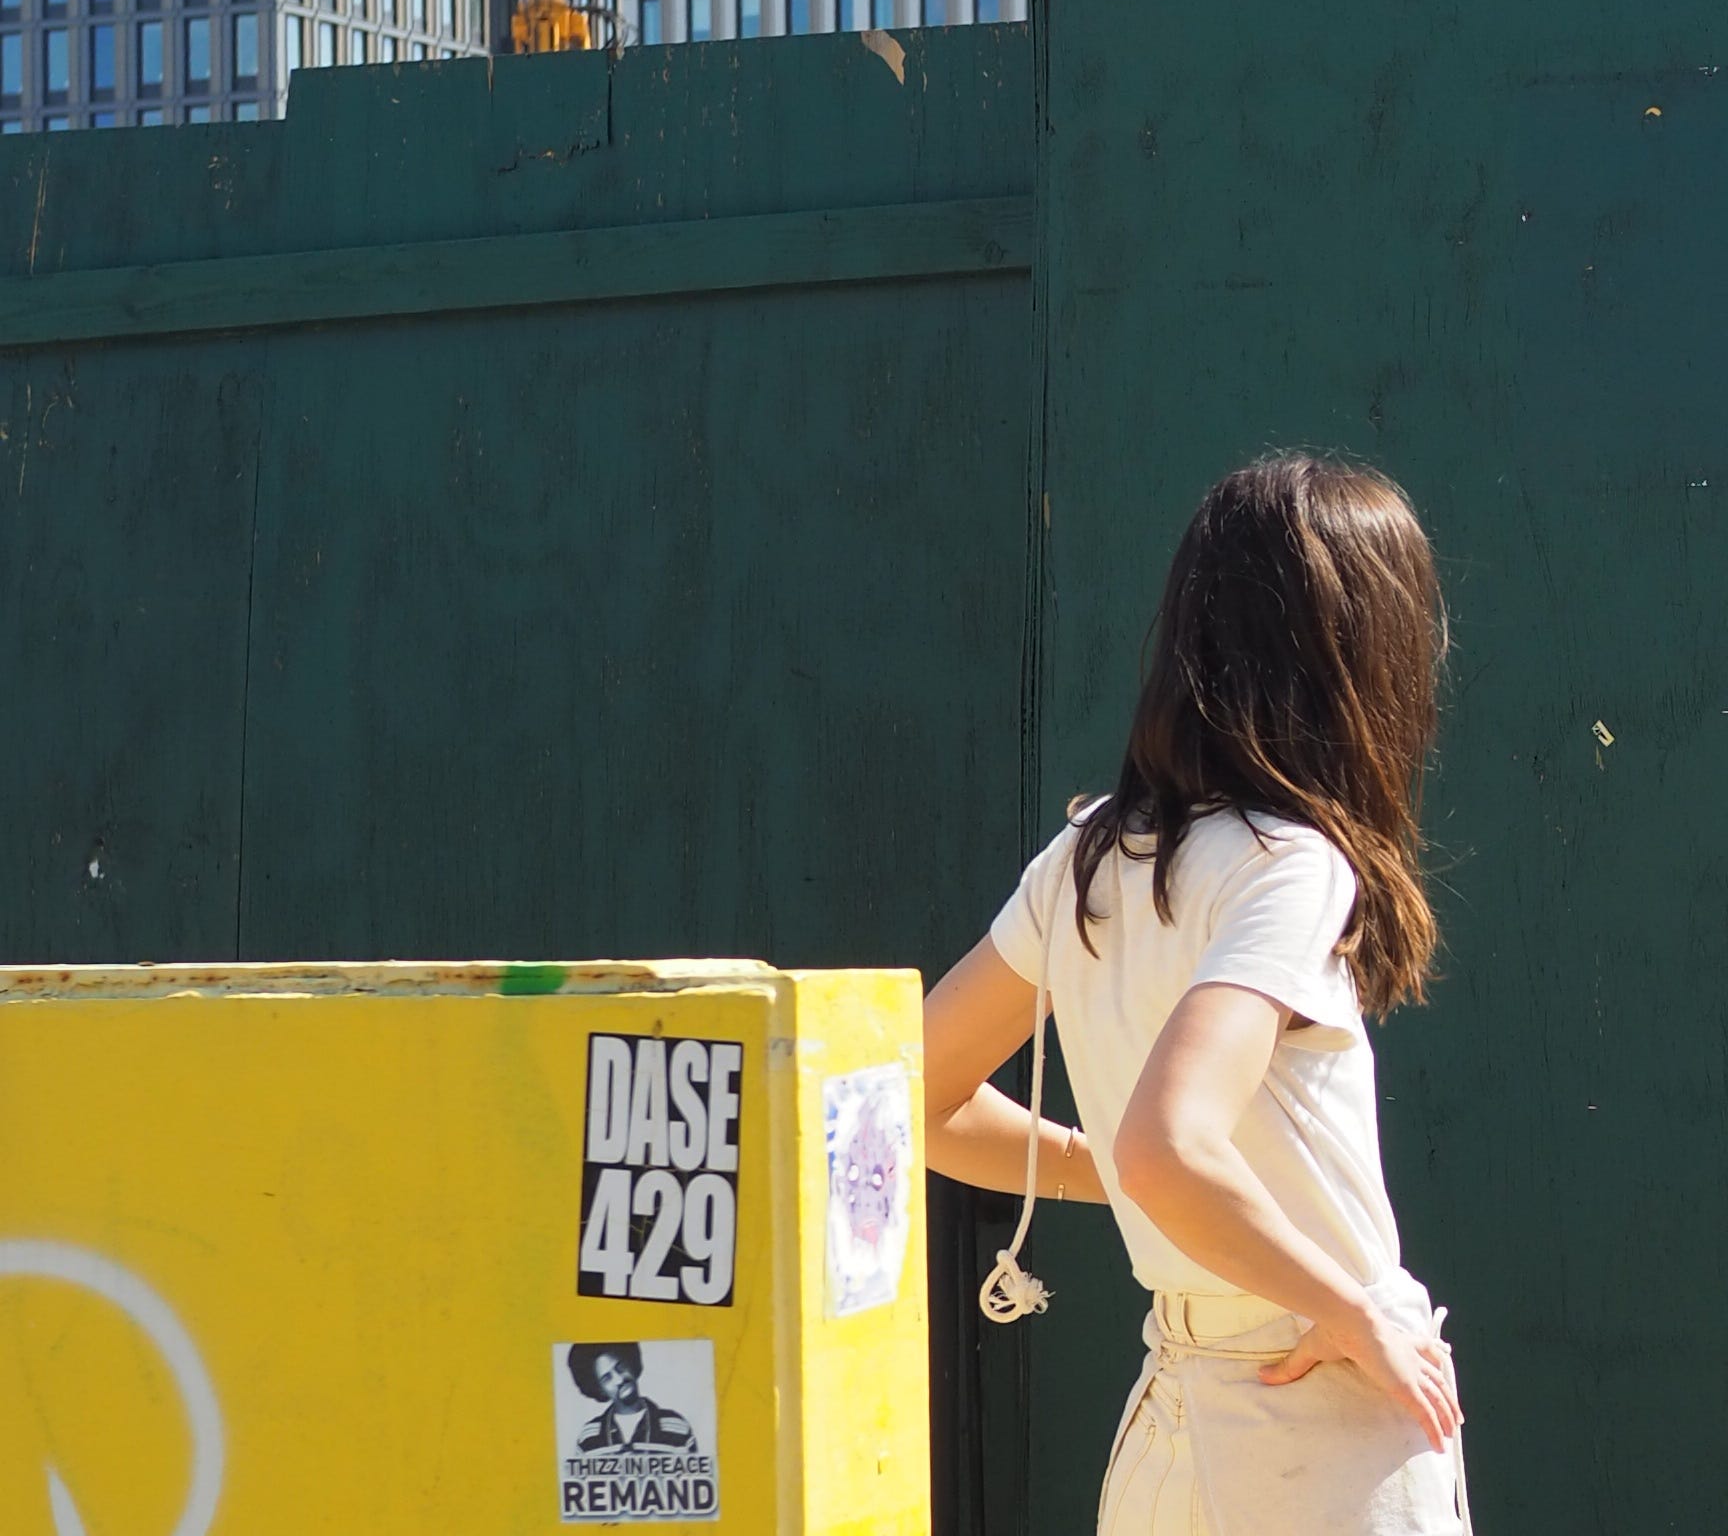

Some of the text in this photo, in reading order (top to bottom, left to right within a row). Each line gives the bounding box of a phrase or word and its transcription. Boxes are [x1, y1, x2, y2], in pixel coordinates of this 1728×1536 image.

[586, 1035, 743, 1172] DASE
[579, 1168, 735, 1306] 429
[563, 1478, 715, 1512] REMAND
[566, 1455, 710, 1476] THIZZ IN PEACE
